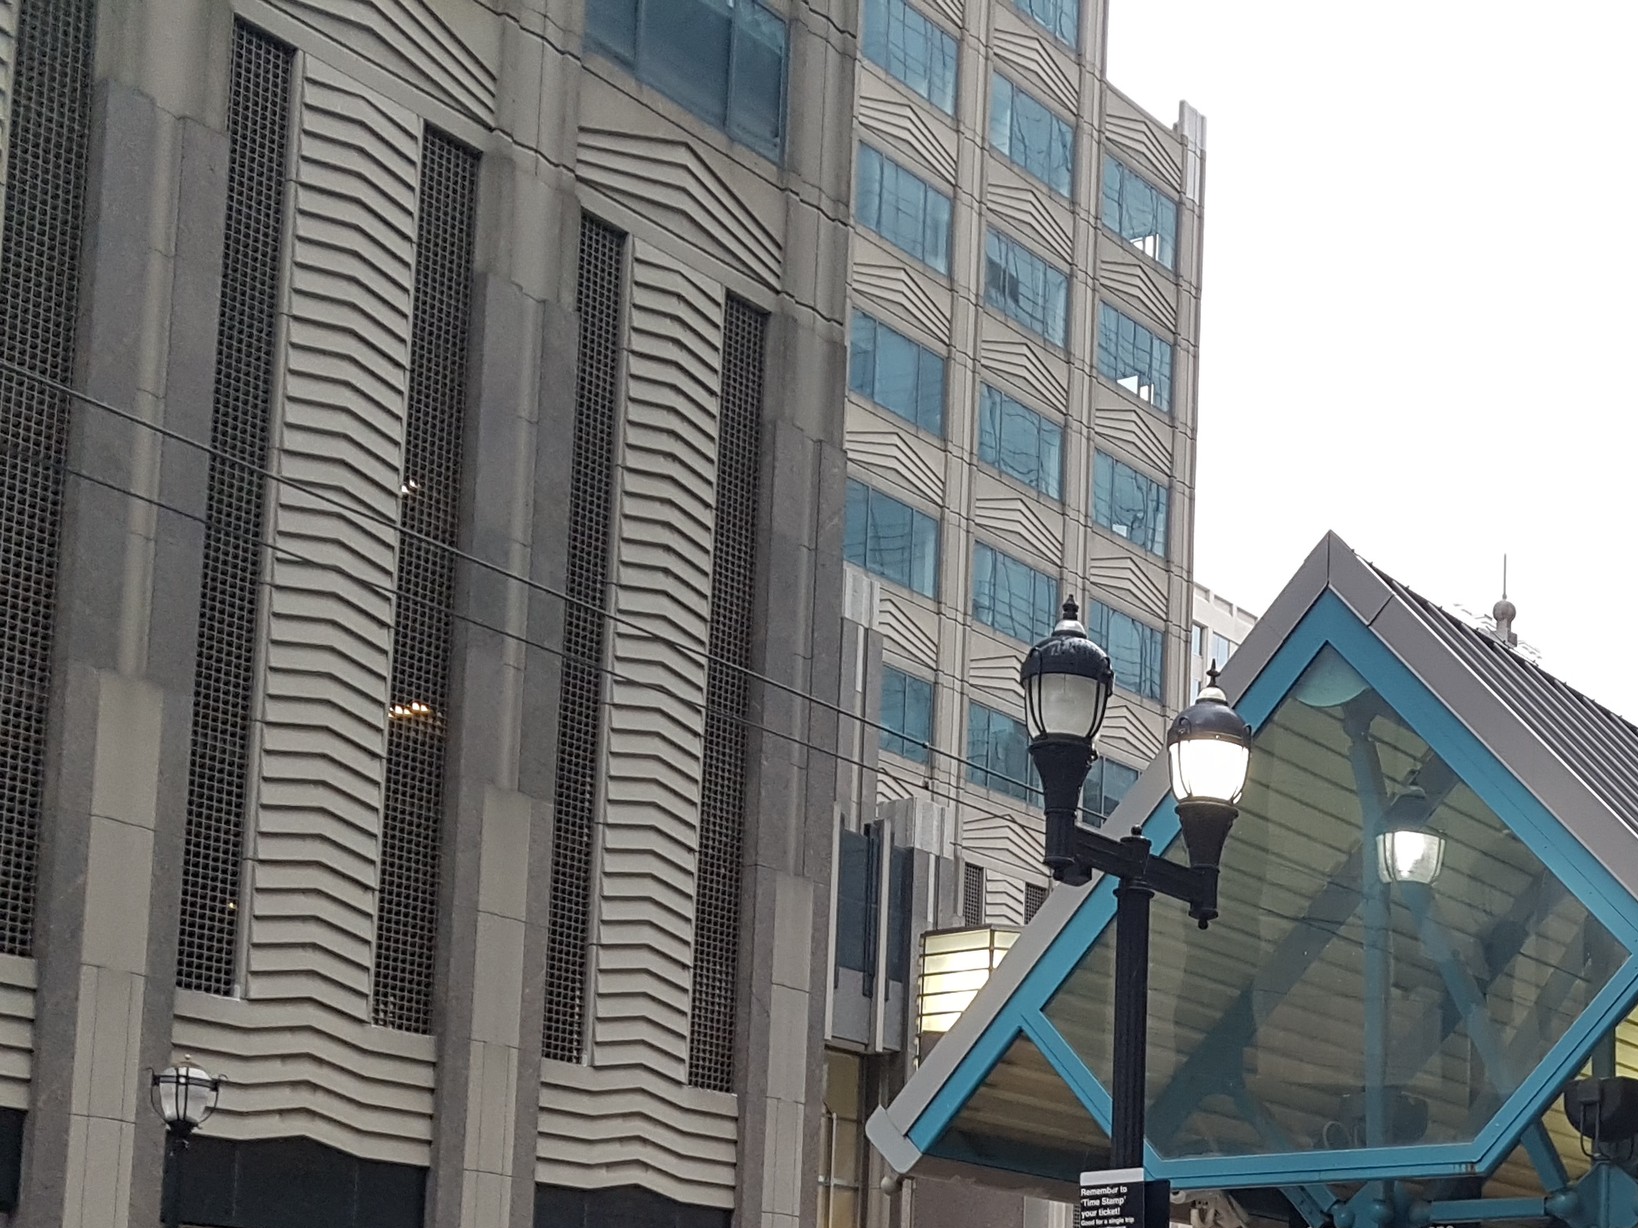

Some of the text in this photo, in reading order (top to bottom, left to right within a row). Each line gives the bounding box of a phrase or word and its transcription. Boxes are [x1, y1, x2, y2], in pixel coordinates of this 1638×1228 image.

[1081, 1185, 1128, 1196] Remember to
[1081, 1207, 1120, 1219] your ticket!
[1109, 1217, 1124, 1225] single
